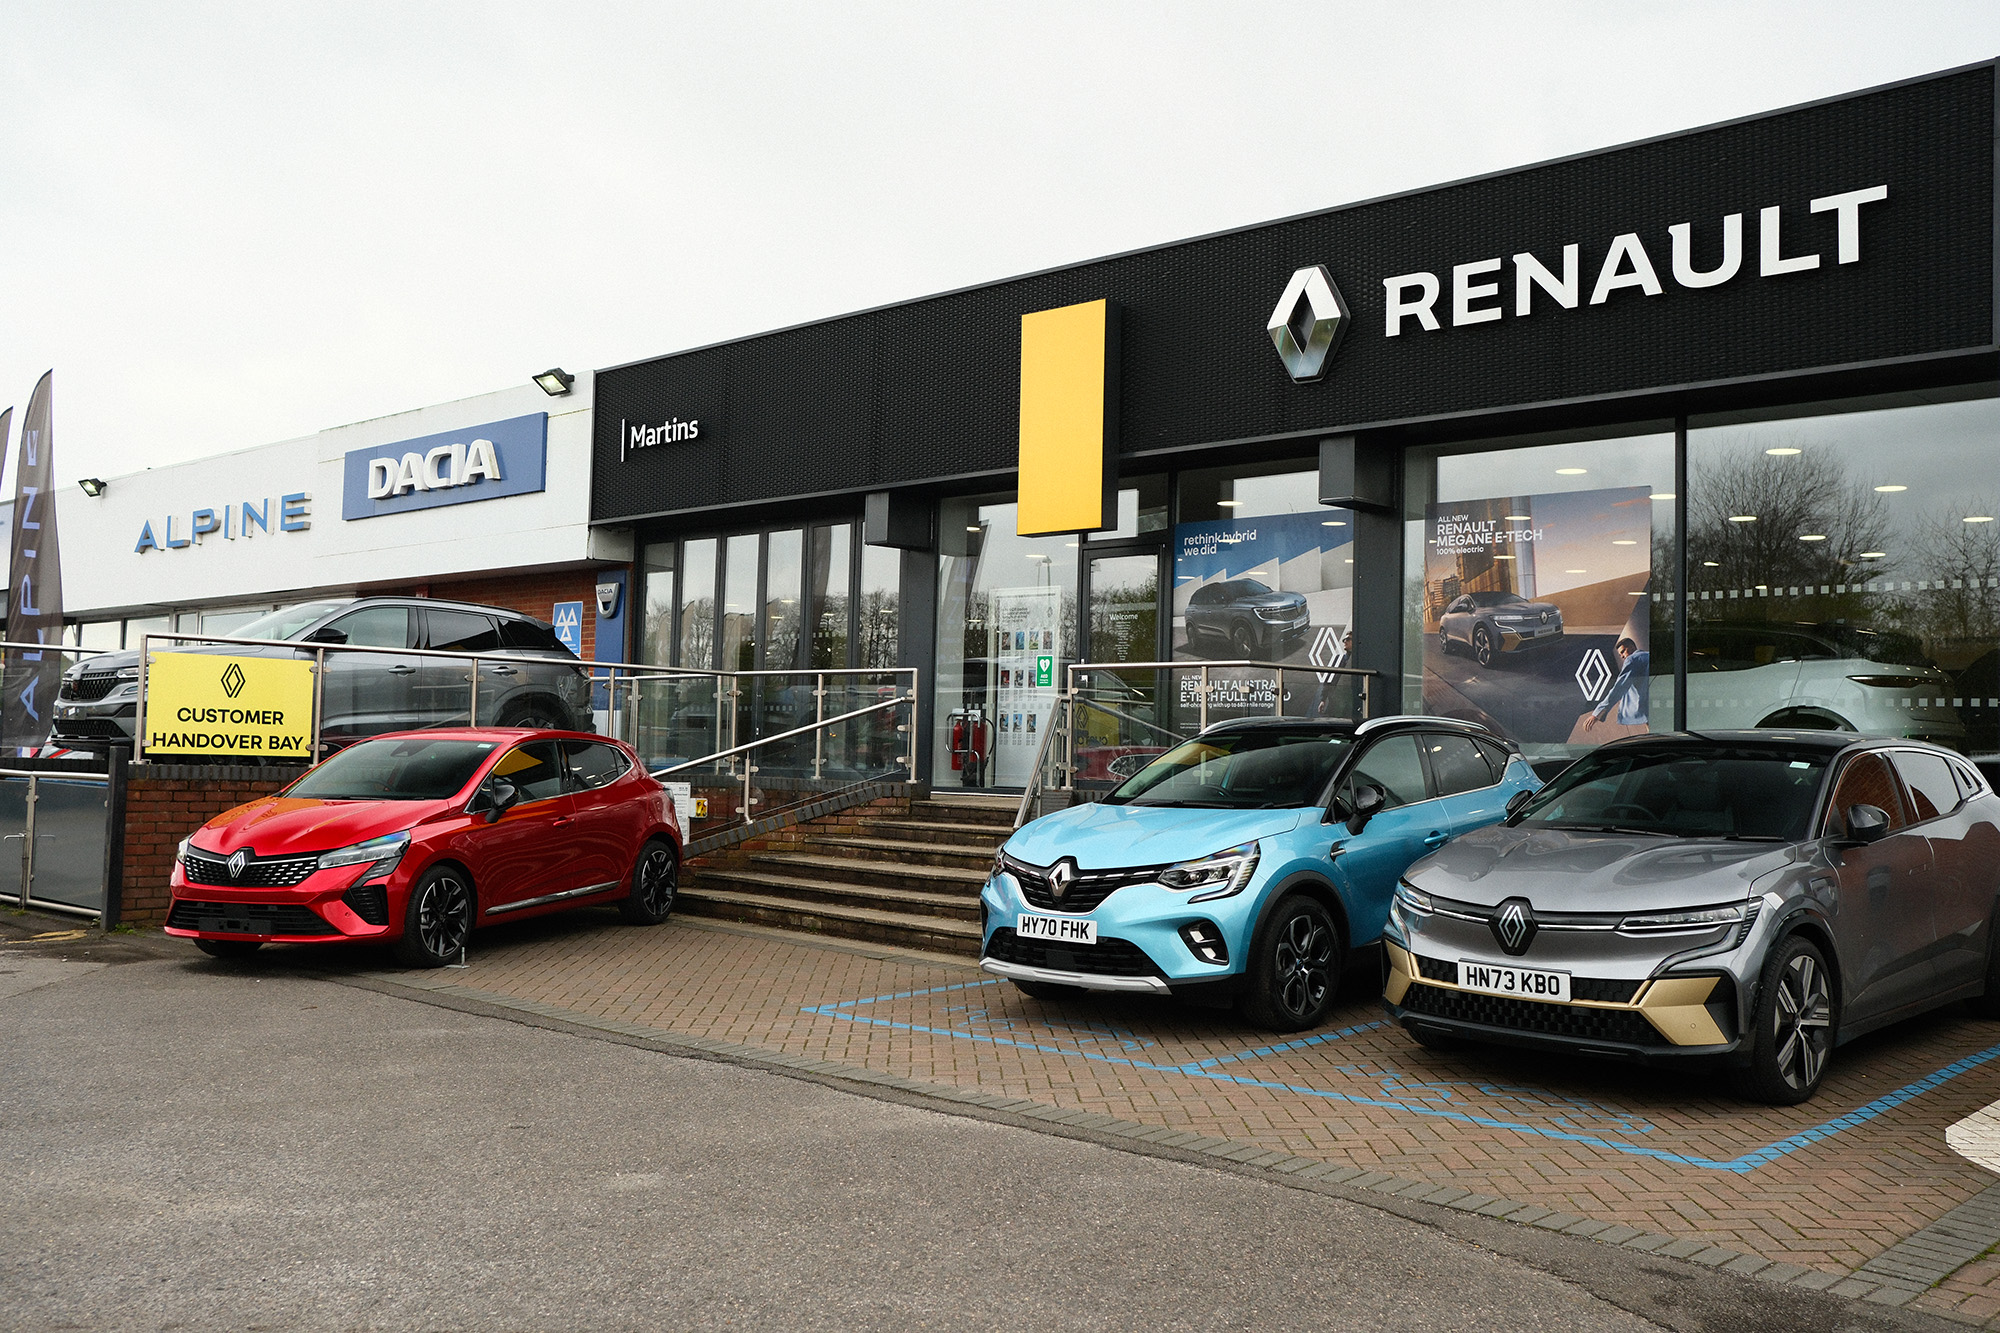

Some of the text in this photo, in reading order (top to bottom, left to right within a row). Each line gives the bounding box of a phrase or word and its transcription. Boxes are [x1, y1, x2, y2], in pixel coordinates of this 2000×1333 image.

[1382, 184, 1888, 337] RENAULT
[630, 417, 699, 449] Martins
[367, 438, 502, 500] DACIA
[134, 491, 313, 554] ALPINE
[1437, 515, 1451, 523] ALL
[1437, 520, 1497, 535] RENAULT
[1184, 529, 1257, 546] rethink hybrid
[1436, 528, 1543, 547] MEGANE E-TECH
[1184, 544, 1217, 556] we did
[1436, 545, 1484, 555] 100% electric
[19, 430, 44, 723] ALPINE
[1109, 612, 1138, 620] Welcome
[1220, 691, 1248, 702] FULL
[177, 707, 284, 725] CUSTOMER
[152, 732, 304, 750] HANDOVER BAY
[1022, 916, 1090, 940] HY70 FHK
[1466, 966, 1560, 996] HN73 KBO
